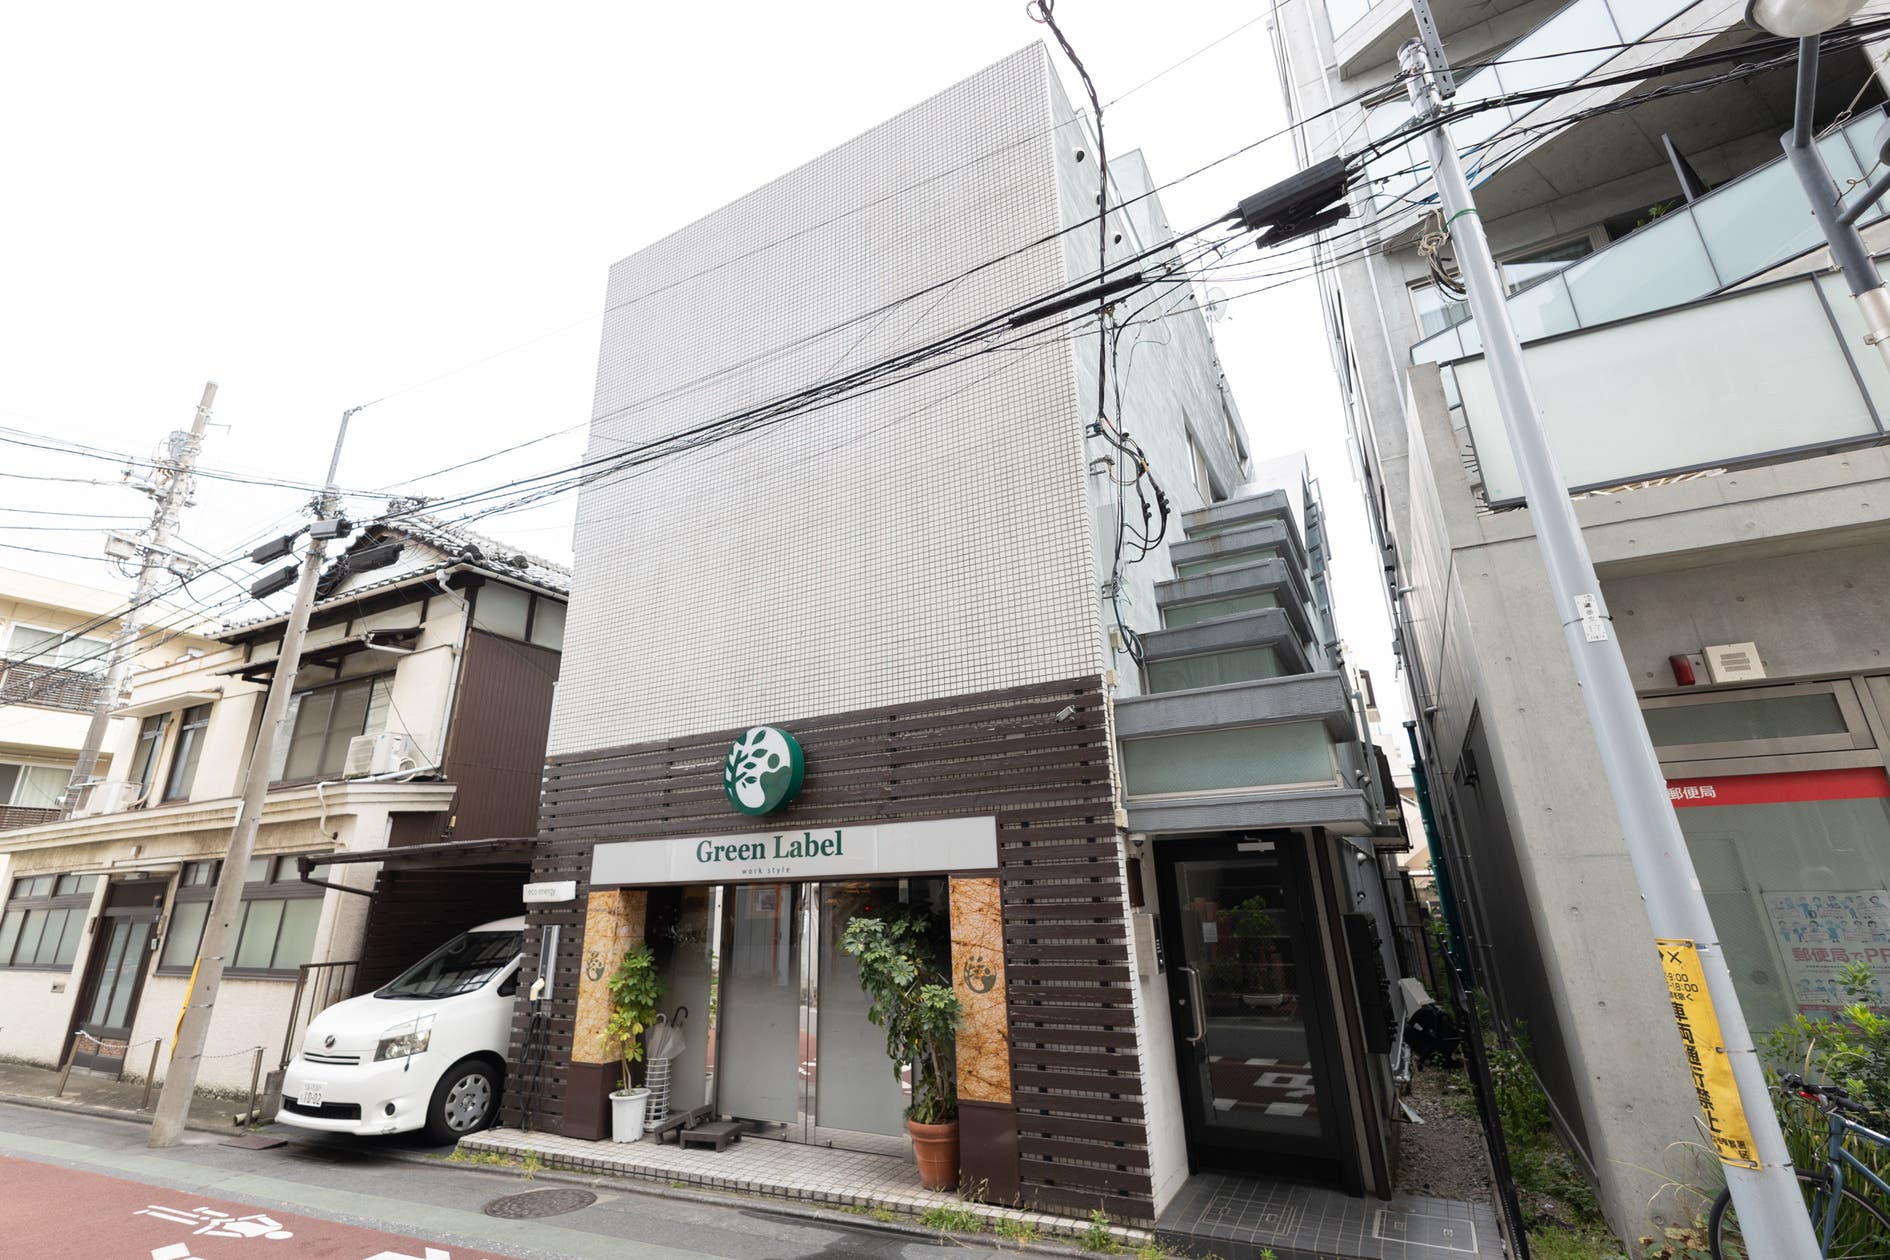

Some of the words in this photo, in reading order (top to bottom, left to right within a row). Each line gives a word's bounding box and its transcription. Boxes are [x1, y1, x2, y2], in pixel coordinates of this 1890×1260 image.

[696, 840, 766, 863] Green
[773, 830, 843, 858] Label
[742, 866, 763, 875] work
[767, 866, 791, 875] style
